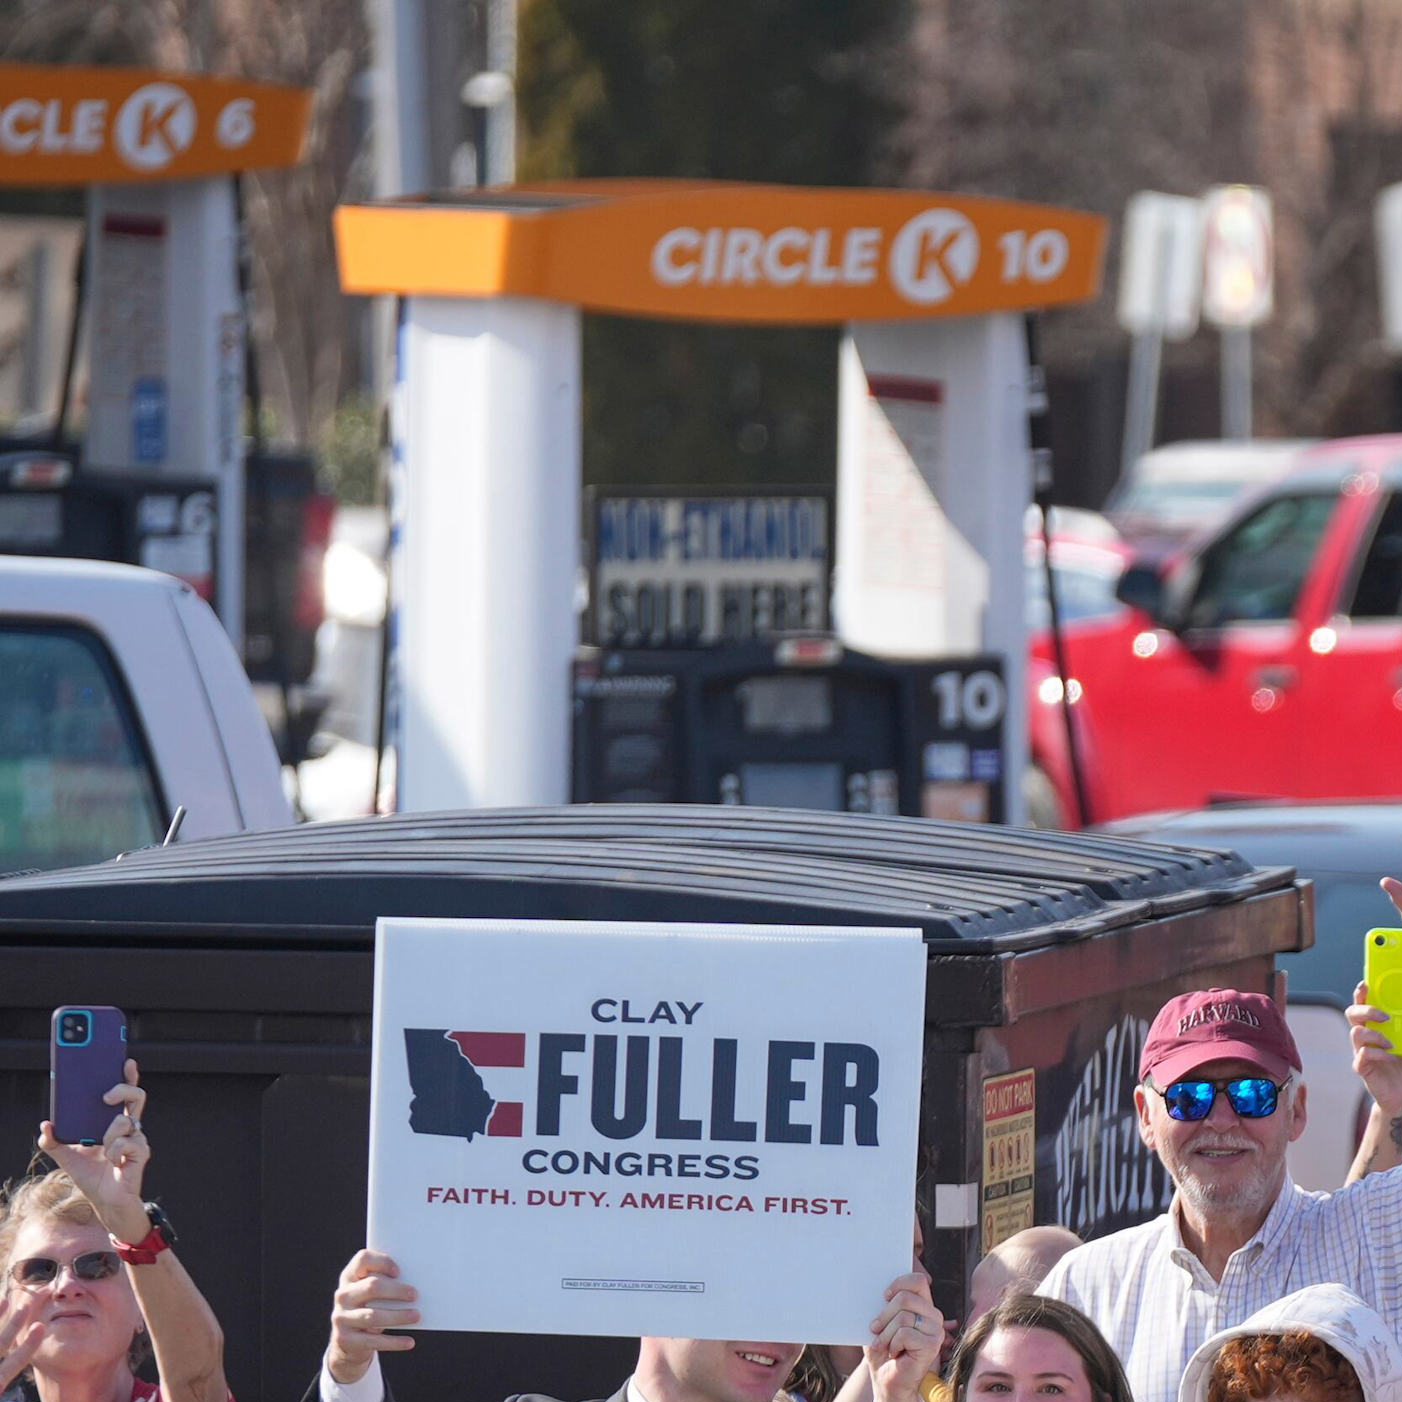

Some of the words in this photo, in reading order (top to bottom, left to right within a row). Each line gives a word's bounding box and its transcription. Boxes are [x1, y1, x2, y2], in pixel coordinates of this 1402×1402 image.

[215, 99, 257, 149] 6
[651, 226, 882, 285] CIRCLE
[898, 217, 974, 298] K
[996, 229, 1070, 282] 10
[932, 671, 1006, 728] 10
[591, 998, 704, 1025] CLAY
[1177, 1001, 1262, 1037] HARVARD
[535, 1032, 880, 1147] FULLER
[986, 1088, 997, 1116] DO
[998, 1084, 1014, 1112] NOT
[1014, 1080, 1034, 1107] PARK
[522, 1149, 760, 1180] CONGRESS
[426, 1187, 517, 1206] FAITH.
[527, 1190, 610, 1208] DUTY.
[620, 1192, 754, 1213] AMERICA
[764, 1196, 852, 1216] FIRST.
